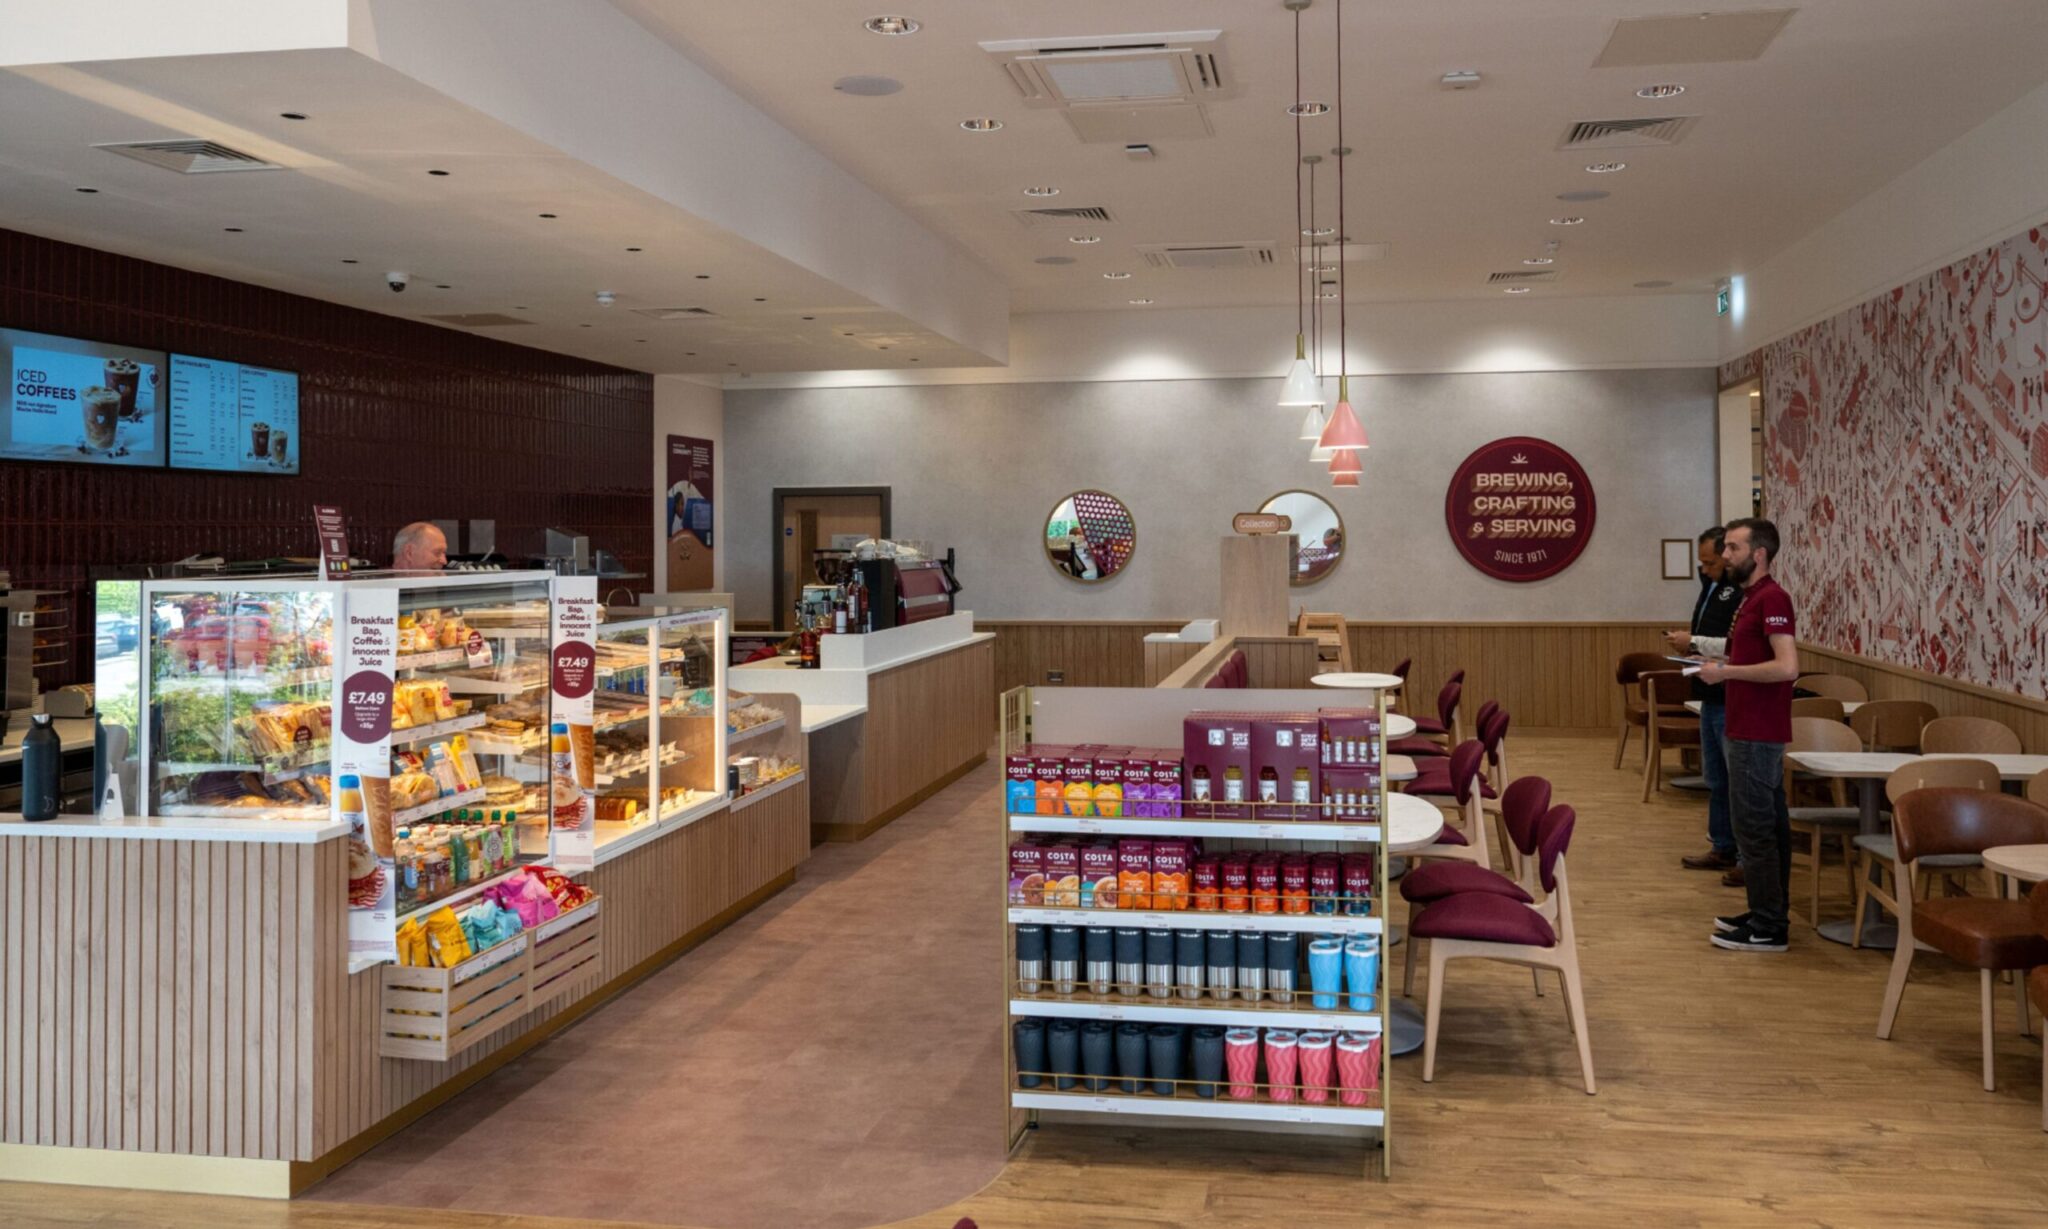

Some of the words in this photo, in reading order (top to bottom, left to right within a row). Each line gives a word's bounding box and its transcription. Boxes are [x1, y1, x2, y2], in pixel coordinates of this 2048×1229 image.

[17, 369, 47, 383] ICED
[17, 383, 76, 400] COFFEES
[1475, 472, 1573, 490] BREWING,
[1473, 496, 1576, 512] CRAFTING
[1240, 519, 1276, 528] Collection
[1472, 521, 1484, 534] &
[1490, 519, 1576, 534] SERVING
[1494, 550, 1524, 564] SINCE
[1526, 549, 1548, 564] 1971
[558, 597, 594, 605] Breakfast
[350, 616, 394, 625] Breakfast
[560, 622, 592, 630] innocent
[362, 626, 382, 636] Bap,
[352, 636, 383, 646] Coffee
[352, 647, 390, 656] innocent
[358, 657, 382, 666] Juice
[558, 657, 588, 668] £7.49
[348, 692, 386, 704] £7.49
[1008, 766, 1033, 774] COSTA
[1037, 768, 1062, 776] COSTA
[1066, 768, 1090, 776] COSTA
[1154, 770, 1179, 778] COSTA
[1012, 850, 1040, 859] COSTA
[1047, 852, 1075, 860] COSTA
[1084, 854, 1113, 862] COSTA
[1121, 855, 1148, 863] COSTA
[1155, 856, 1183, 864] COSTA
[1312, 877, 1334, 885] COSTA
[1346, 878, 1369, 886] COSTA
